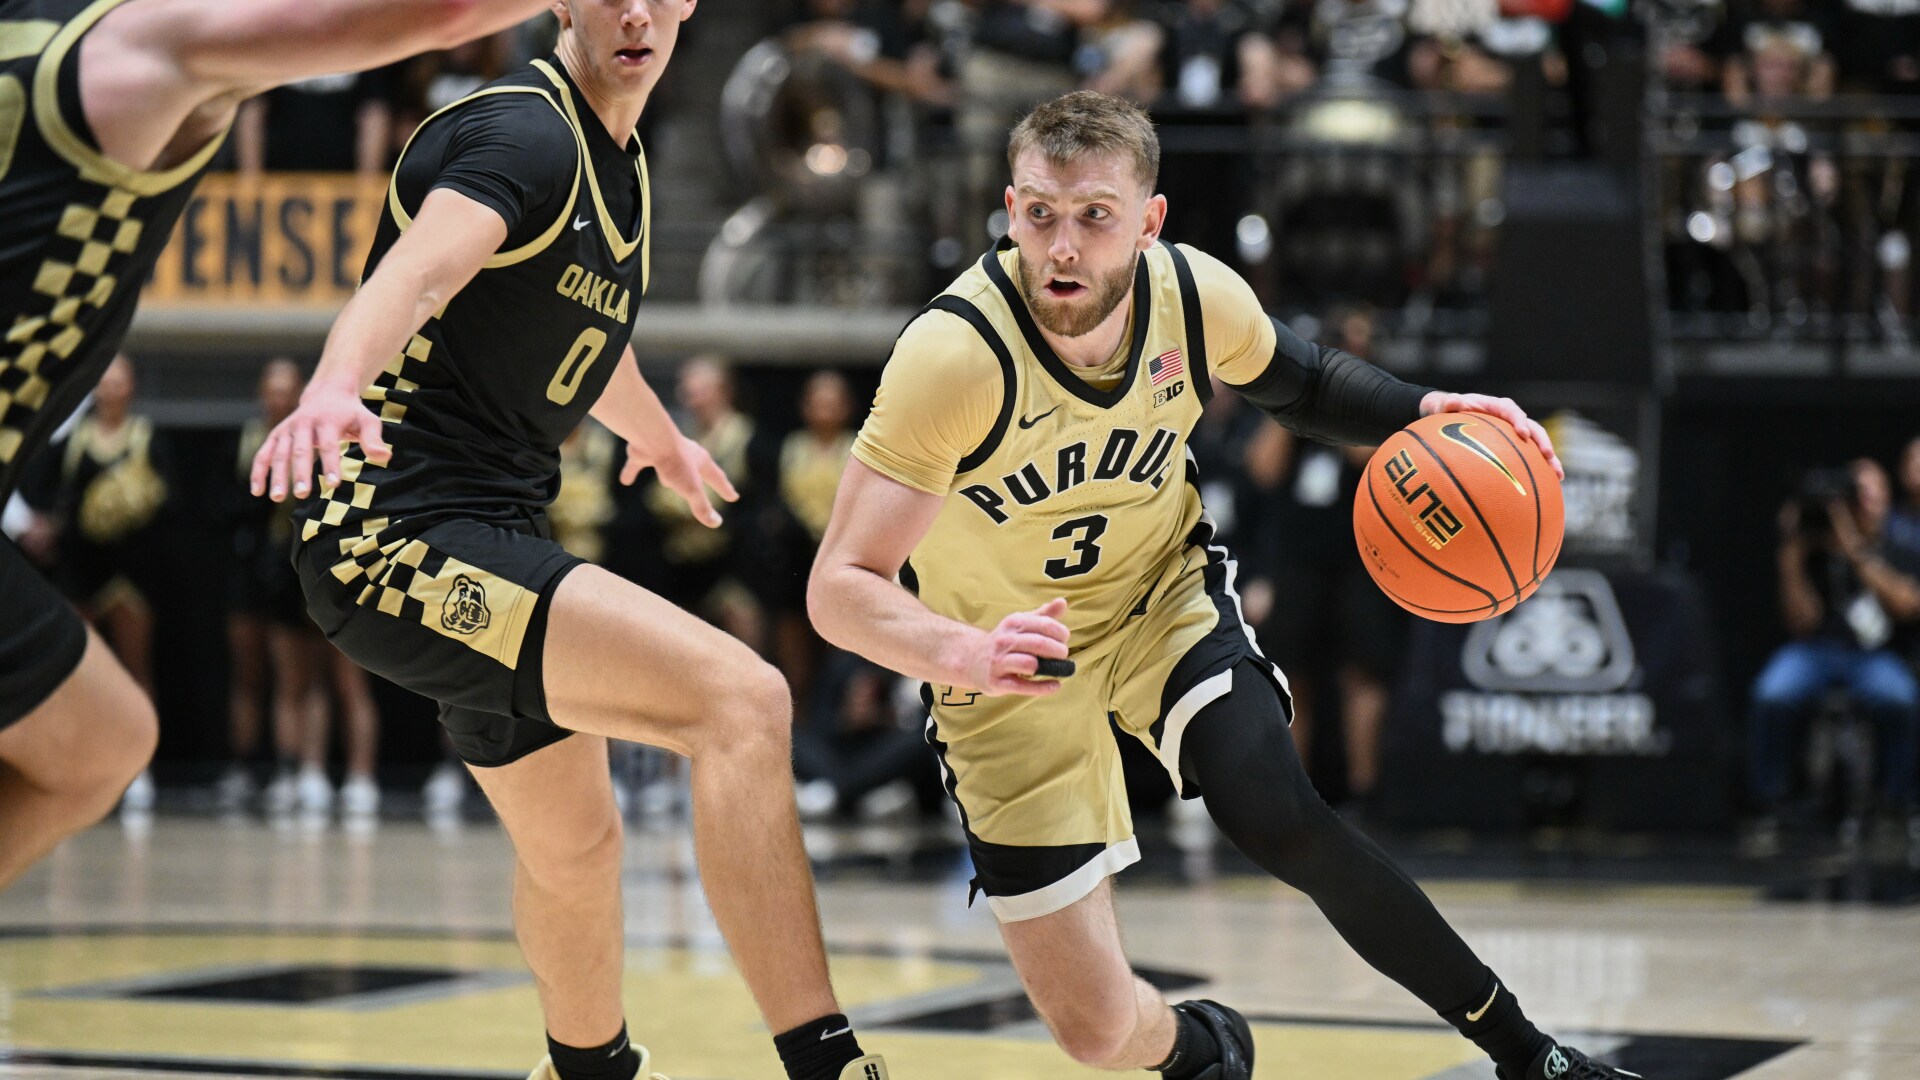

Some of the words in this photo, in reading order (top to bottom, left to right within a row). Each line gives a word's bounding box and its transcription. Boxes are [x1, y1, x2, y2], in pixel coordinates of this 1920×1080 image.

[177, 195, 357, 290] ENSE
[556, 263, 631, 325] OAKLA
[546, 326, 608, 406] 0
[1384, 447, 1466, 546] ELITE
[1043, 513, 1109, 580] 3
